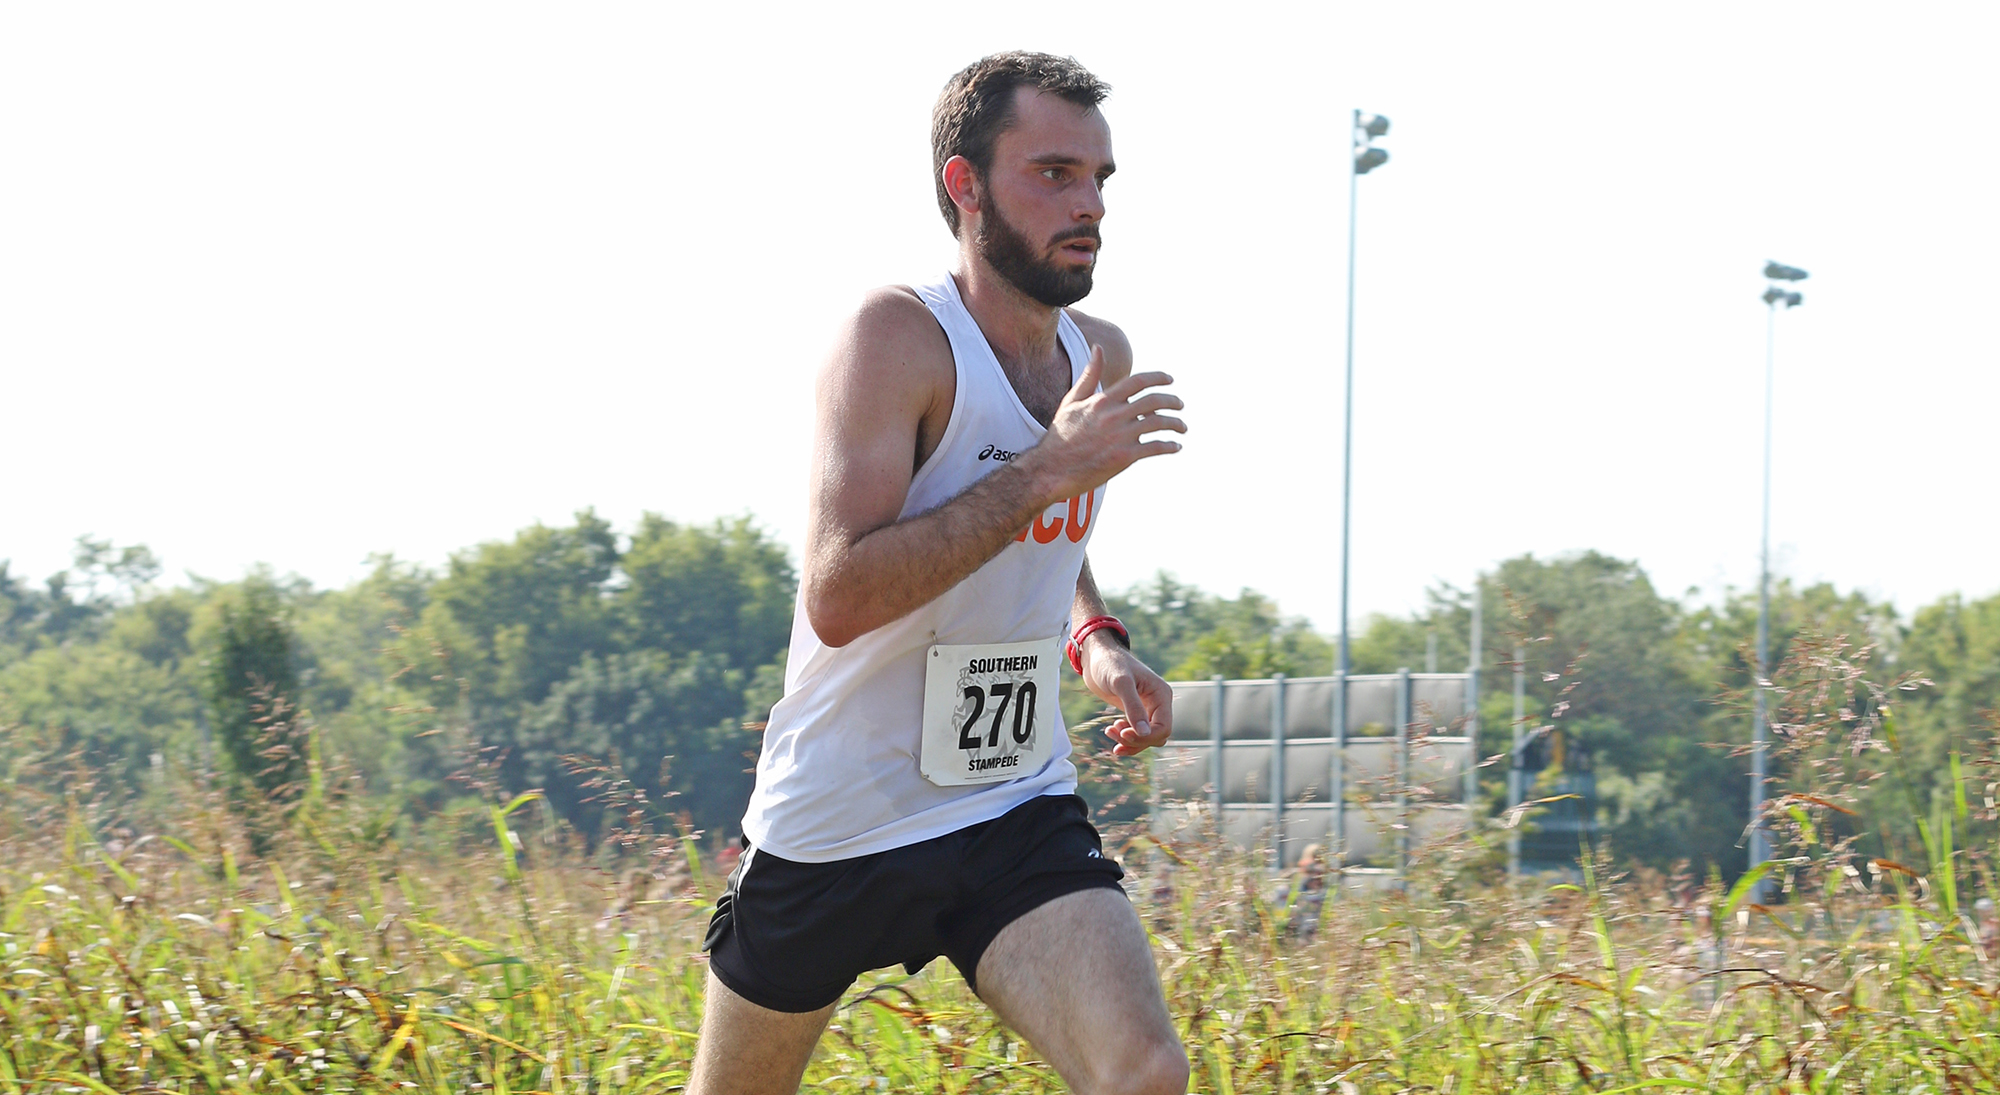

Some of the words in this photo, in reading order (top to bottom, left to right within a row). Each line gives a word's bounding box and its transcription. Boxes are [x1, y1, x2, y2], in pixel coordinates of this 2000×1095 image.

[993, 449, 1021, 462] asic
[1014, 488, 1095, 544] CU
[969, 655, 1038, 674] SOUTHERN
[958, 681, 1037, 749] 270
[968, 755, 1019, 771] STAMPEDE
